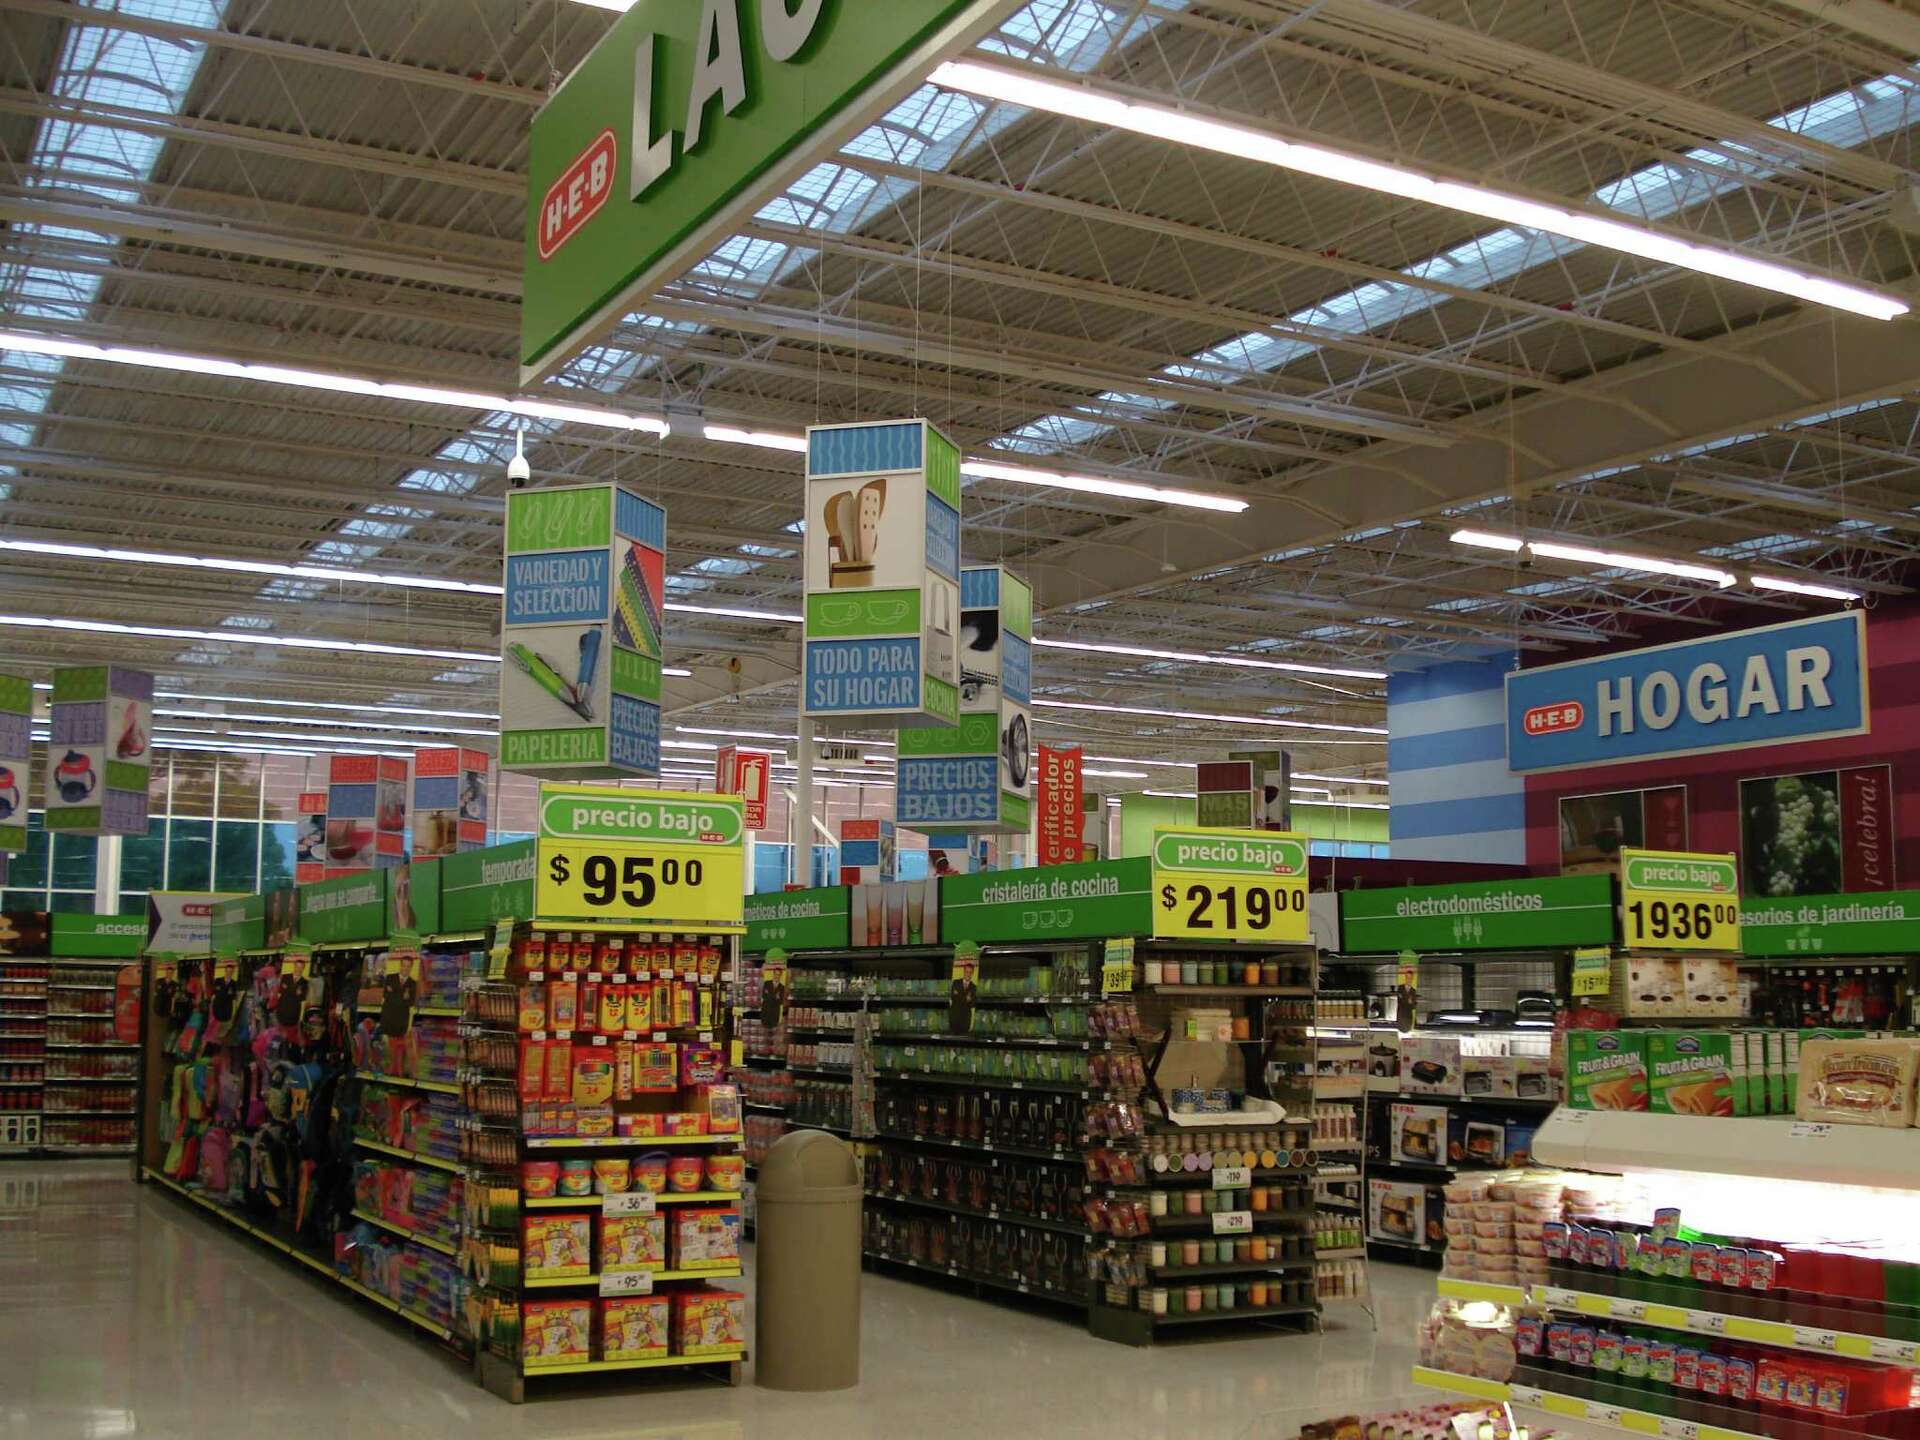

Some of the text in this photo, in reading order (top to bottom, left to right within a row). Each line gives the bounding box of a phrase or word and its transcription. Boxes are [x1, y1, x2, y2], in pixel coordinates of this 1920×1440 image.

[514, 556, 602, 586] VARIEDAD Y
[813, 645, 914, 675] TODO PARA
[814, 676, 914, 706] SU HOGAR
[1597, 645, 1833, 737] HOGAR
[613, 698, 657, 738] PRECIOS
[508, 732, 599, 762] PAPELERIA
[612, 732, 657, 767] BAJOS
[904, 761, 991, 791] PRECIOS
[904, 792, 991, 819] BAJOS
[1044, 753, 1060, 866] erificador
[1060, 758, 1078, 839] precios
[572, 805, 652, 831] precio
[659, 806, 713, 837] bajo
[1177, 842, 1284, 869] precio bajo
[982, 872, 1120, 904] cristalería de cocina
[1643, 864, 1721, 887] precio bajo
[778, 900, 789, 919] de
[790, 899, 820, 918] cocina
[1396, 890, 1544, 917] electrodomésticos
[1798, 905, 1819, 923] de
[1821, 900, 1905, 926] jardinería
